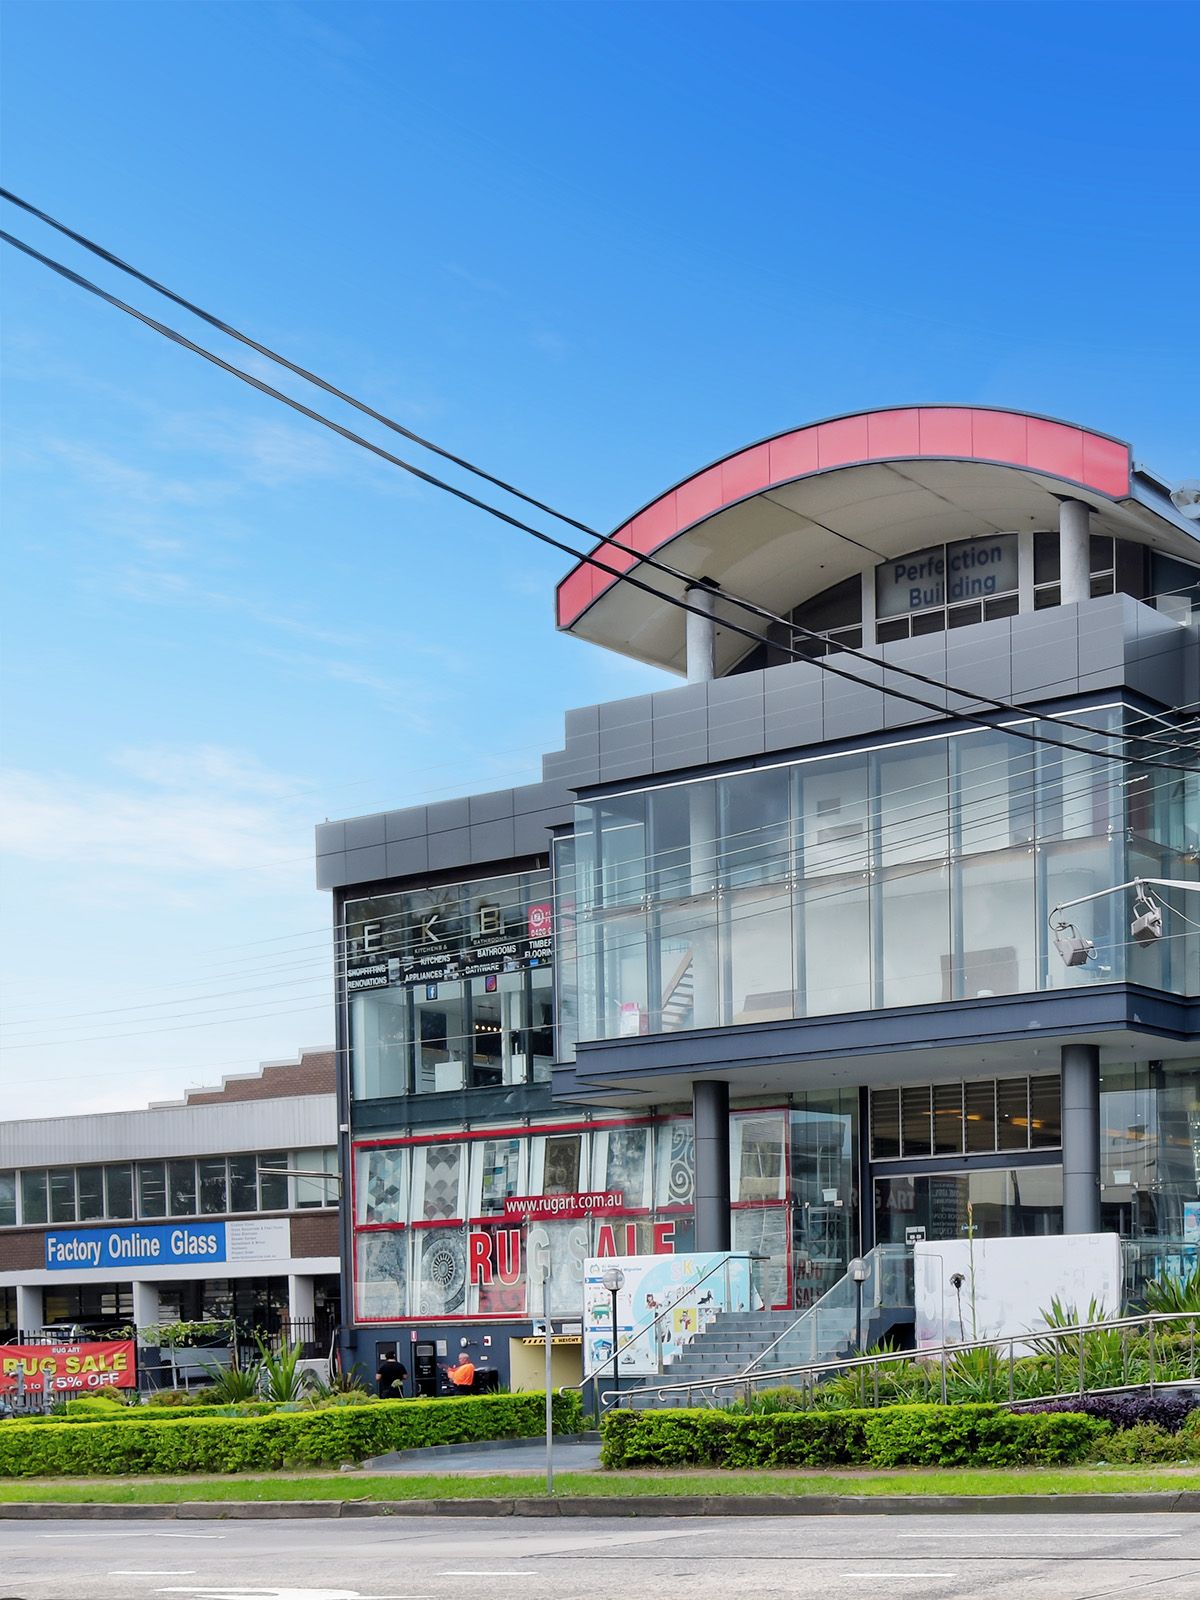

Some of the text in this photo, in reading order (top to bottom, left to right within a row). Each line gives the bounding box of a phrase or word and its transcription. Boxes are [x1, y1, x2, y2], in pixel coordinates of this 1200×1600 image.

[894, 546, 1003, 584] Perfection
[909, 575, 997, 607] Building
[420, 954, 451, 966] KITCHENS
[477, 944, 517, 958] BATHROOMS
[524, 948, 553, 958] FLOORIN
[347, 976, 388, 989] RENOVATIONS
[404, 969, 443, 983] APPLIANCES
[506, 1193, 622, 1214] www.rugart.com.au
[886, 1189, 915, 1210] ART
[47, 1237, 102, 1266] Factory
[108, 1232, 161, 1259] Online
[171, 1230, 218, 1255] Glass
[468, 1226, 551, 1287] RUG
[3, 1353, 128, 1376] RUG SALE
[87, 1372, 120, 1386] OFF
